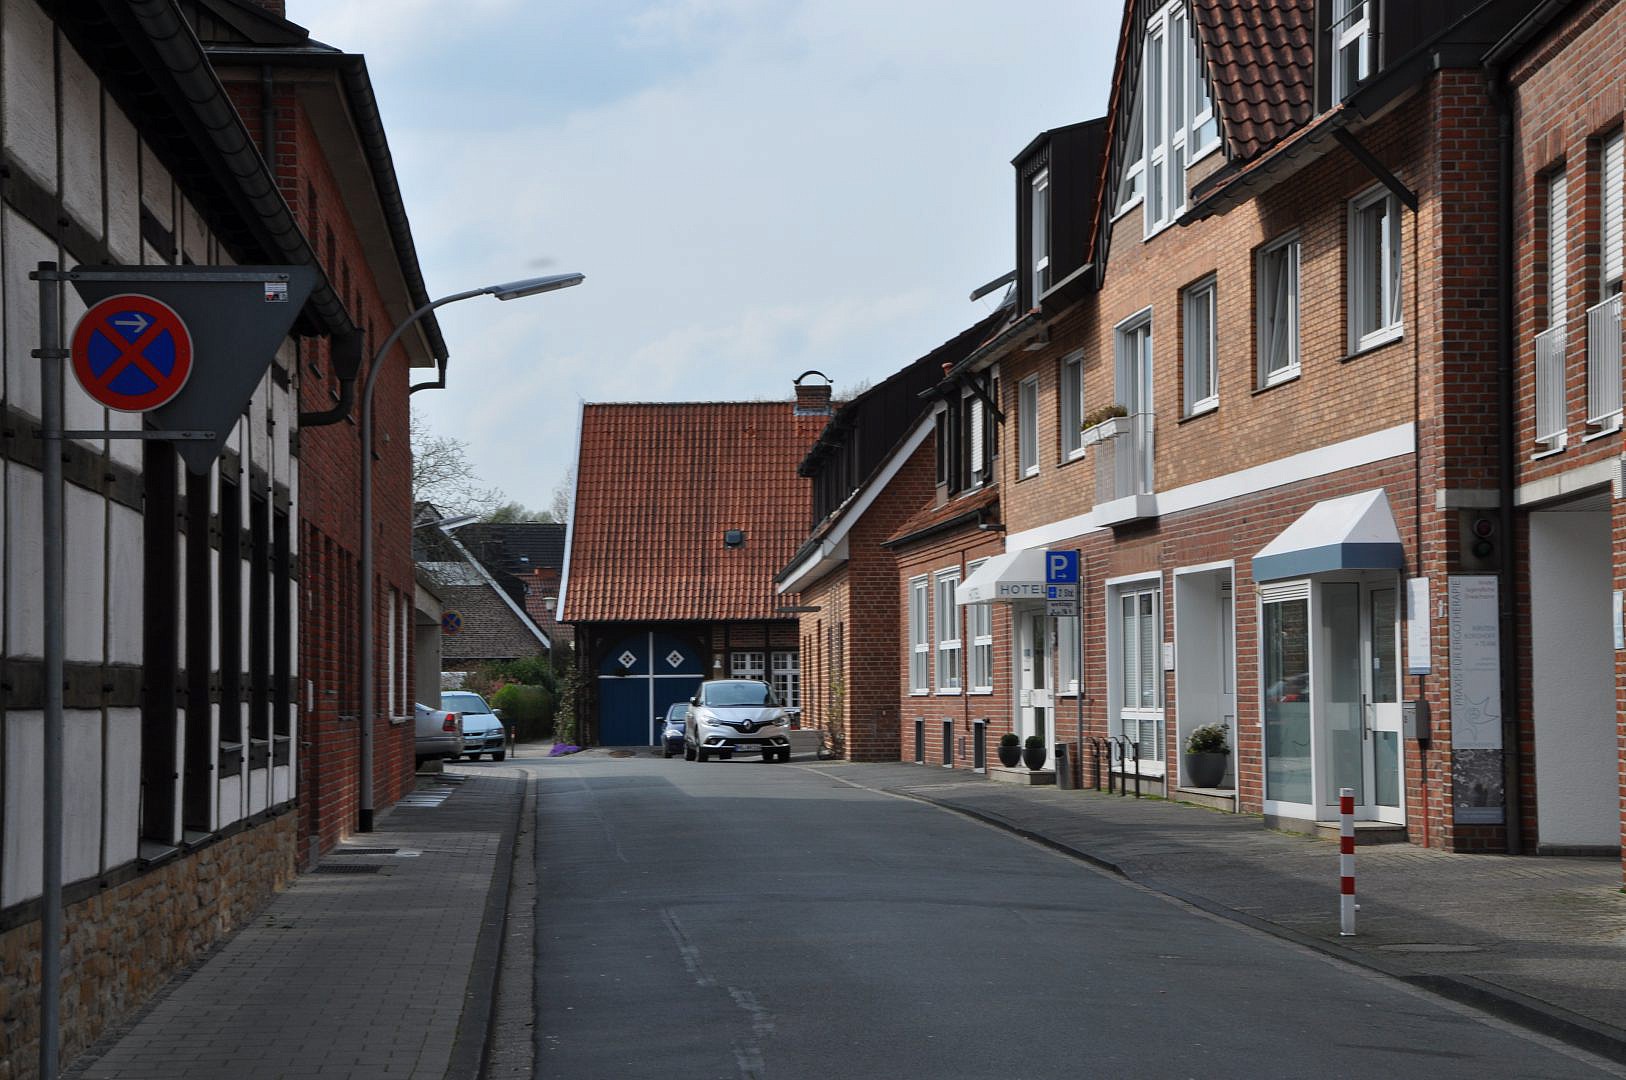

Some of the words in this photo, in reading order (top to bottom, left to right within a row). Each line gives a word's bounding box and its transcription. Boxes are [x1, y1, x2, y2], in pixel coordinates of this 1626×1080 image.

[1050, 555, 1068, 579] P
[1001, 584, 1047, 595] HOTEL
[1451, 579, 1462, 651] ERGOTHERAPIE
[1453, 673, 1464, 706] PRAXIS
